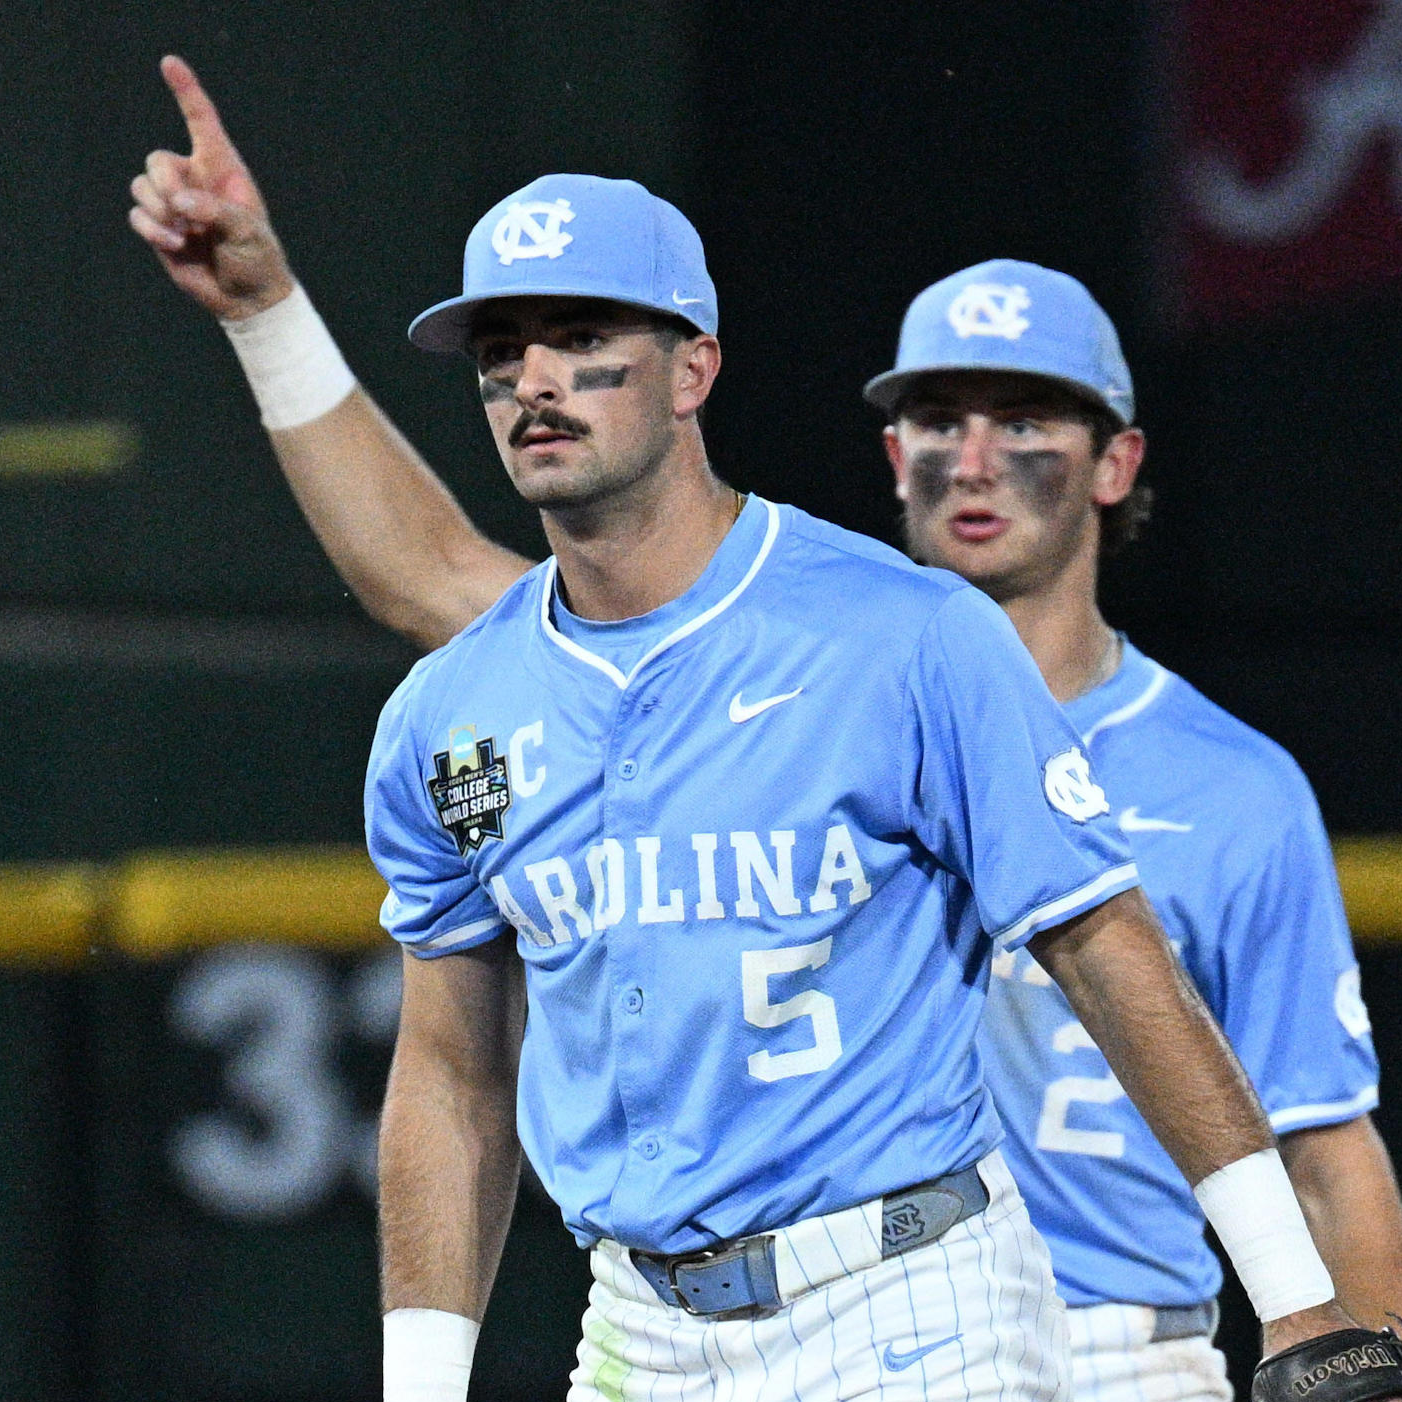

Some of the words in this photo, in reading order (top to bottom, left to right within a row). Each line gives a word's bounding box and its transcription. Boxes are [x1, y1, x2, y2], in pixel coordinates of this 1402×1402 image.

[447, 777, 490, 805] COLLEGE
[509, 720, 546, 798] C
[441, 801, 469, 826] WORLD
[469, 790, 508, 817] SERIES
[490, 823, 872, 948] AROLINA
[741, 935, 843, 1082] 5
[1292, 1343, 1398, 1397] Wilson
